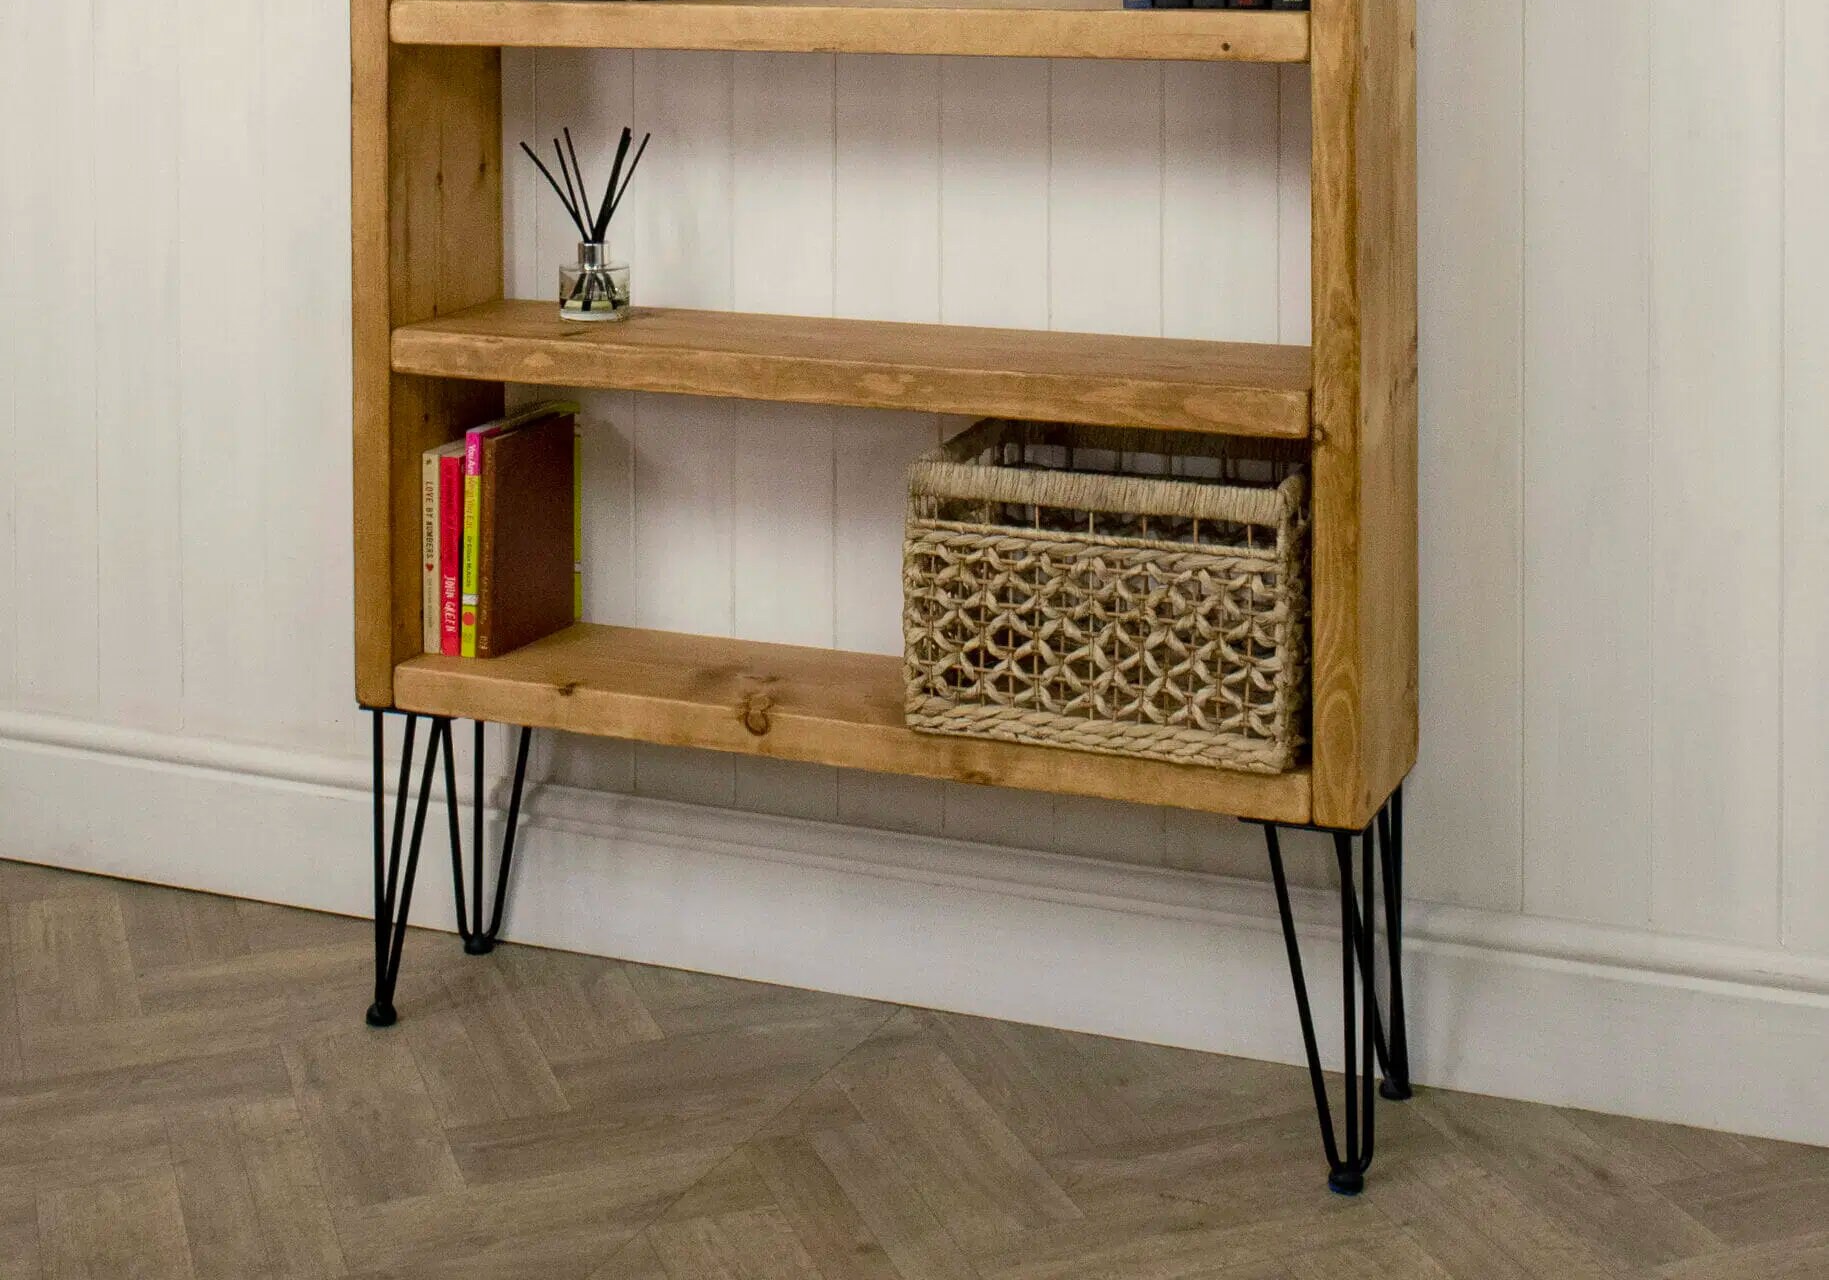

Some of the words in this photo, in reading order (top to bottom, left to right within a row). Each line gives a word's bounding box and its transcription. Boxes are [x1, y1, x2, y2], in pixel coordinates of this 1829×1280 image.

[467, 444, 477, 458] You
[467, 457, 477, 474] Are
[425, 481, 434, 504] LOVE
[425, 507, 434, 519] BY
[425, 521, 434, 559] NUMBERS
[444, 575, 457, 598] JOHN
[444, 601, 457, 632] GREEN
